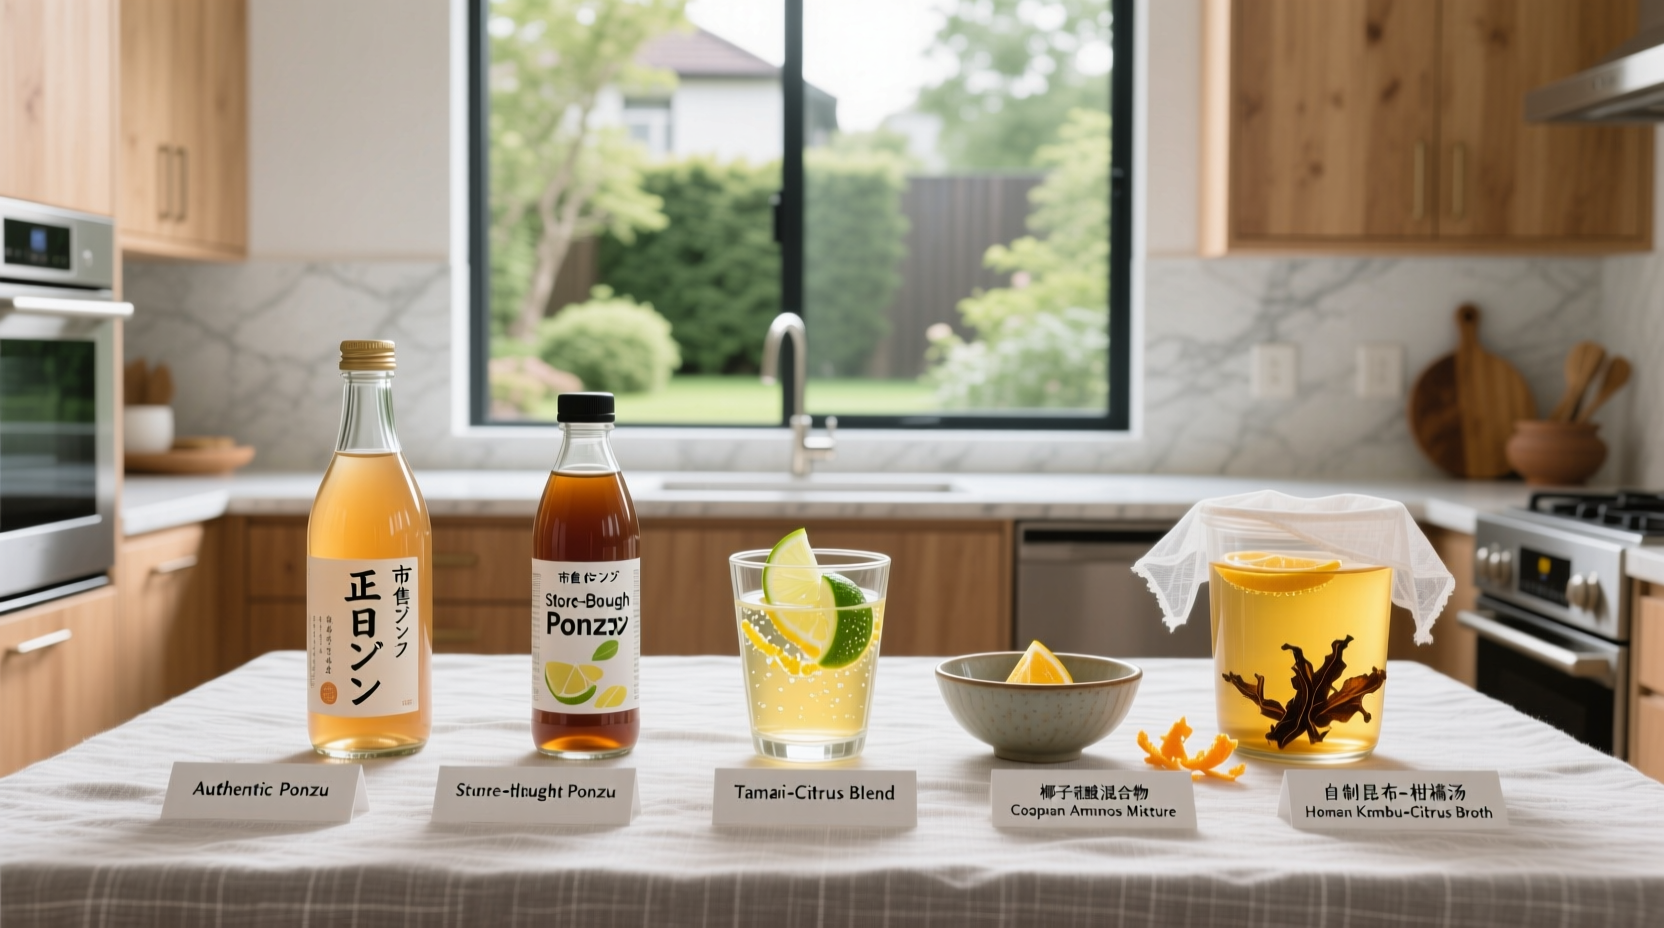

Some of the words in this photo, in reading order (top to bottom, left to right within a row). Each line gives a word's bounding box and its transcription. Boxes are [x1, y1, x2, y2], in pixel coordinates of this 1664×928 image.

[192, 780, 273, 797] Authentic
[279, 782, 329, 797] Ponzu
[568, 784, 616, 798] Ponzu
[849, 785, 895, 800] Blend
[1455, 805, 1493, 819] Broth
